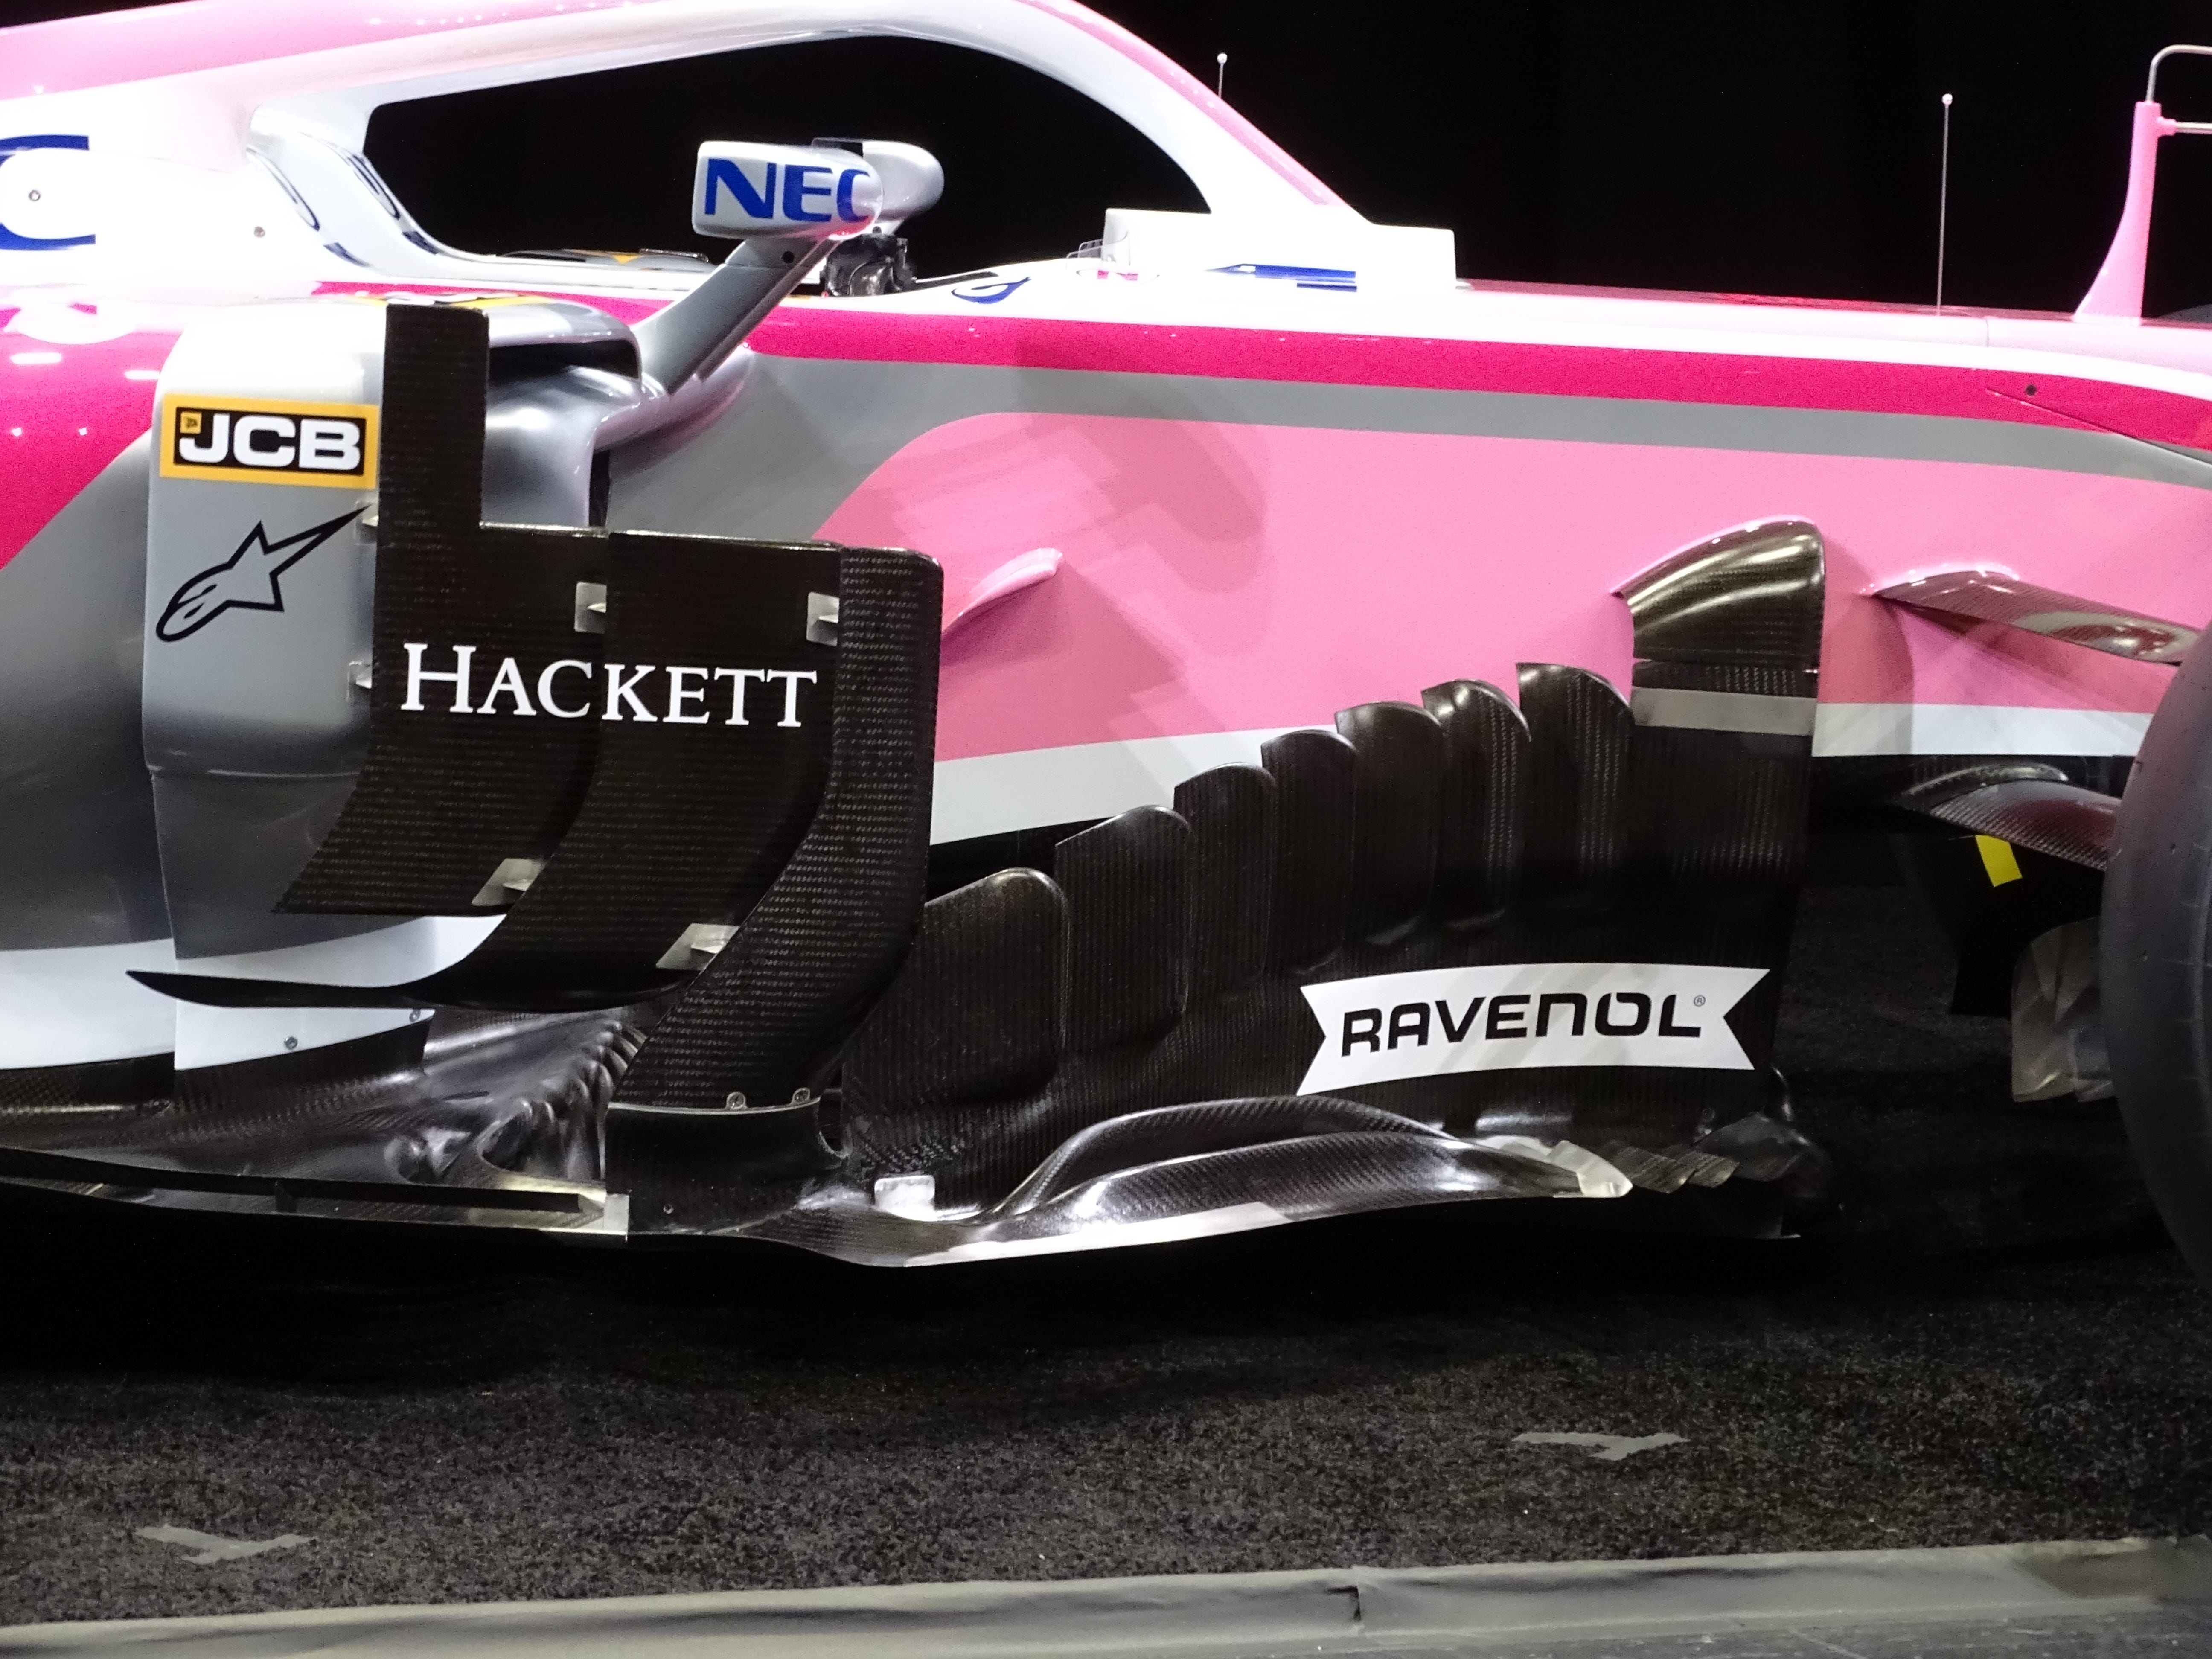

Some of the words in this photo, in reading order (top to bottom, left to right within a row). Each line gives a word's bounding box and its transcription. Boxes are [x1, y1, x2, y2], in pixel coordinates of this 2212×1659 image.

[704, 158, 870, 222] NEC
[179, 413, 360, 471] JCB
[401, 642, 817, 728] HACKETT
[1341, 992, 1702, 1057] RAVENOL
